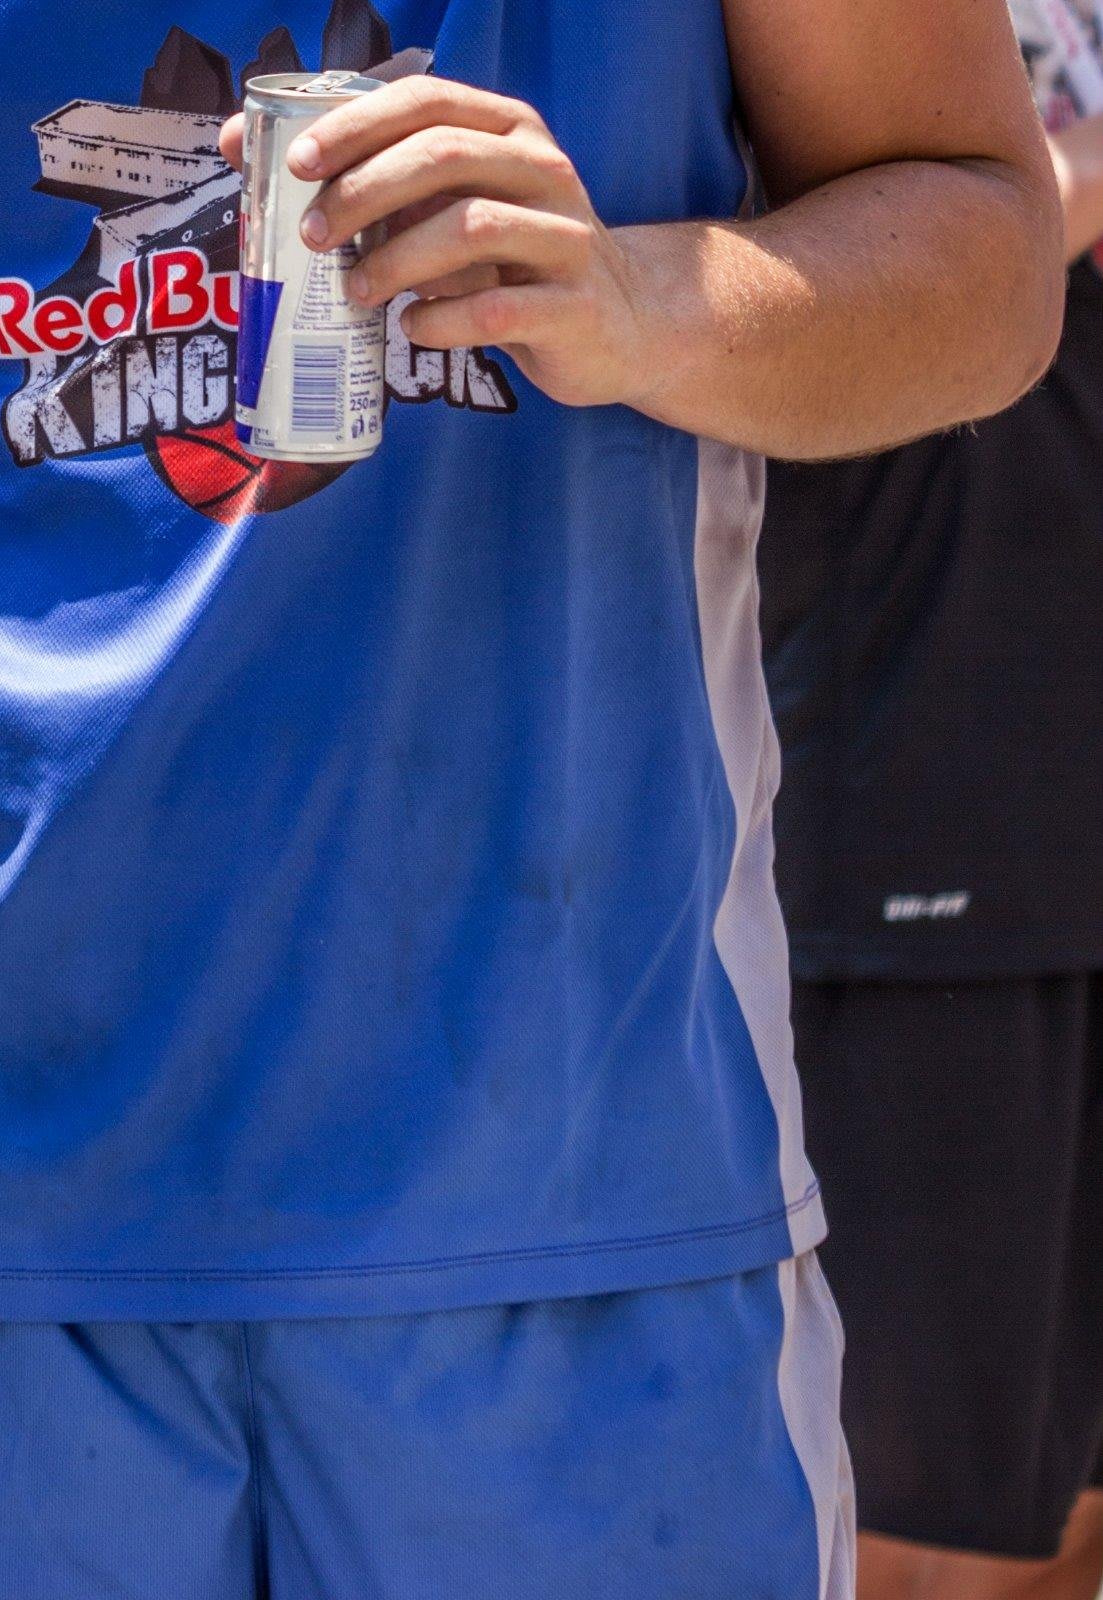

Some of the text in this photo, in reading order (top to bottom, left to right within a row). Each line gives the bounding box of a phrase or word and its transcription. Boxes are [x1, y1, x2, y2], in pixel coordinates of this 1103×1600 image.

[148, 248, 240, 331] Bu
[4, 334, 229, 461] KING
[349, 396, 369, 412] 250
